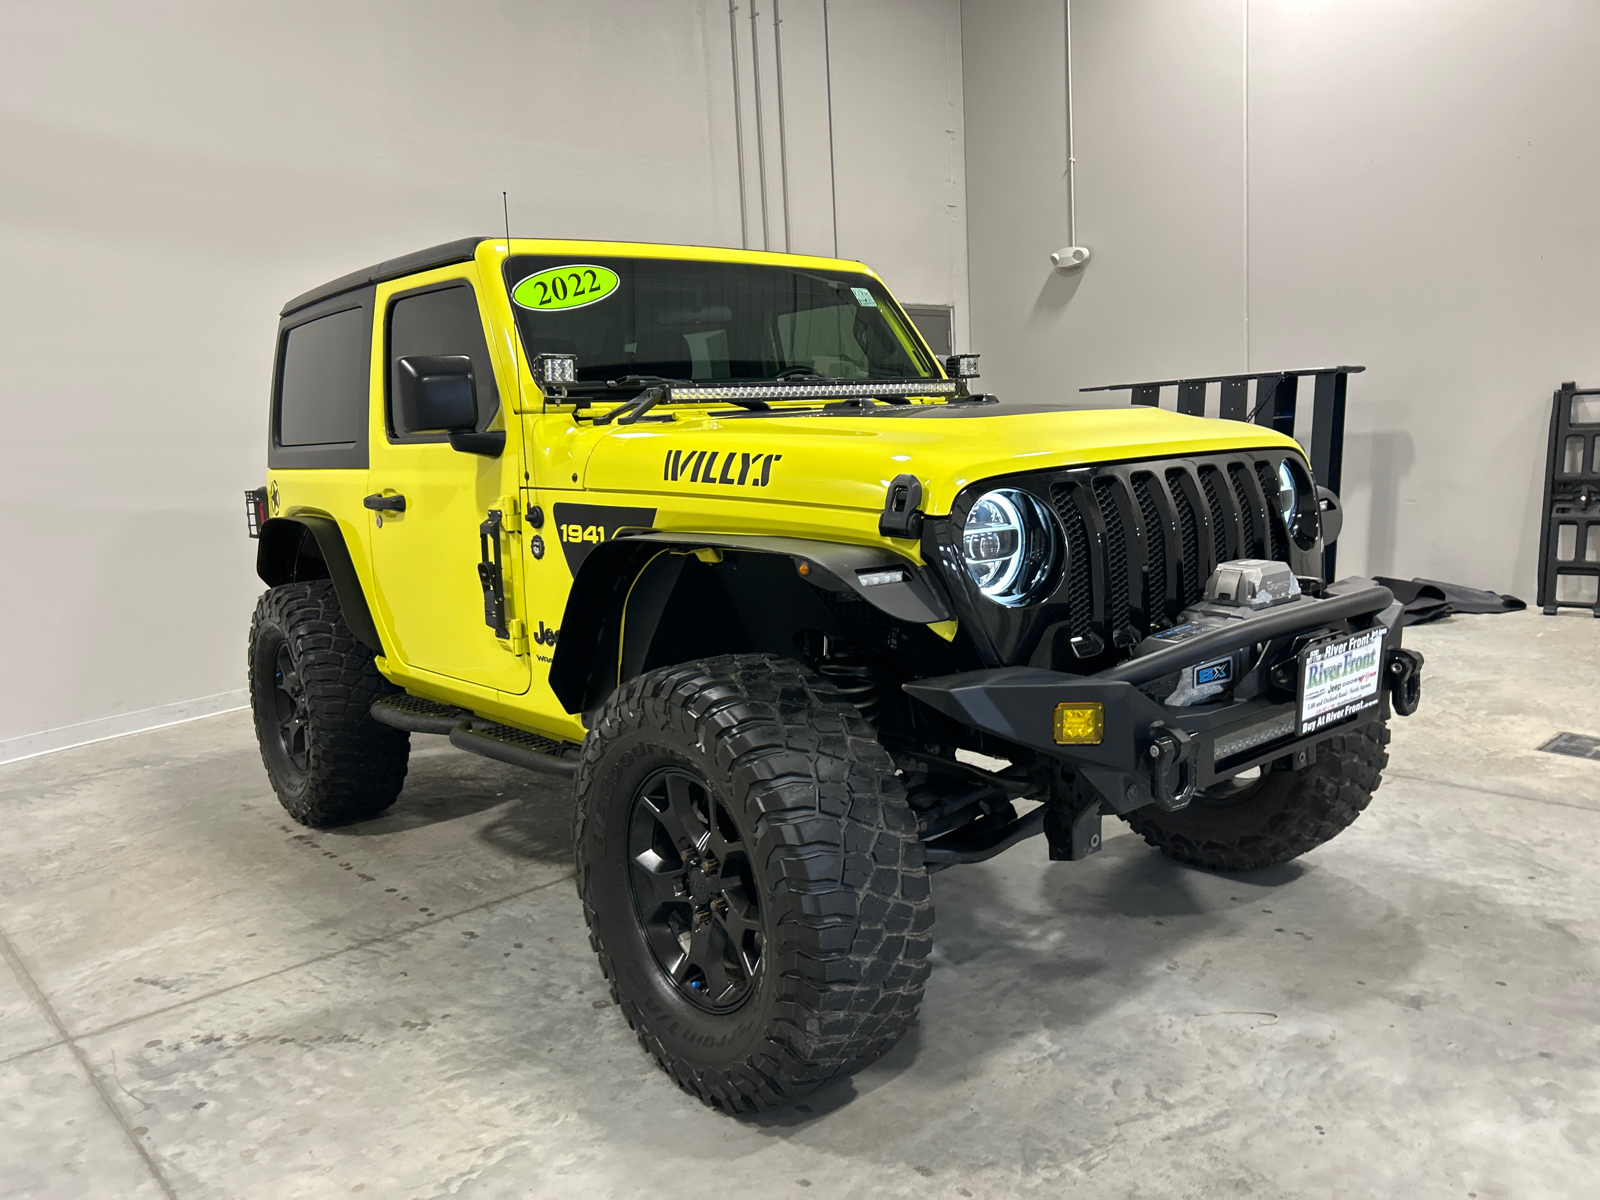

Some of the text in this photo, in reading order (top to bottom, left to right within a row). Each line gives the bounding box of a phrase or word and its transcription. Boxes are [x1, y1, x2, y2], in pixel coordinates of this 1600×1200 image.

[533, 269, 601, 307] 2022
[663, 450, 783, 487] WILLYS
[560, 523, 605, 544] 1941
[533, 621, 561, 647] Jee
[1325, 642, 1347, 657] River
[1349, 633, 1370, 650] Front
[1306, 662, 1342, 689] River
[1342, 648, 1376, 677] Front
[1303, 721, 1315, 733] Buy
[1317, 715, 1326, 728] At
[1326, 709, 1344, 724] River
